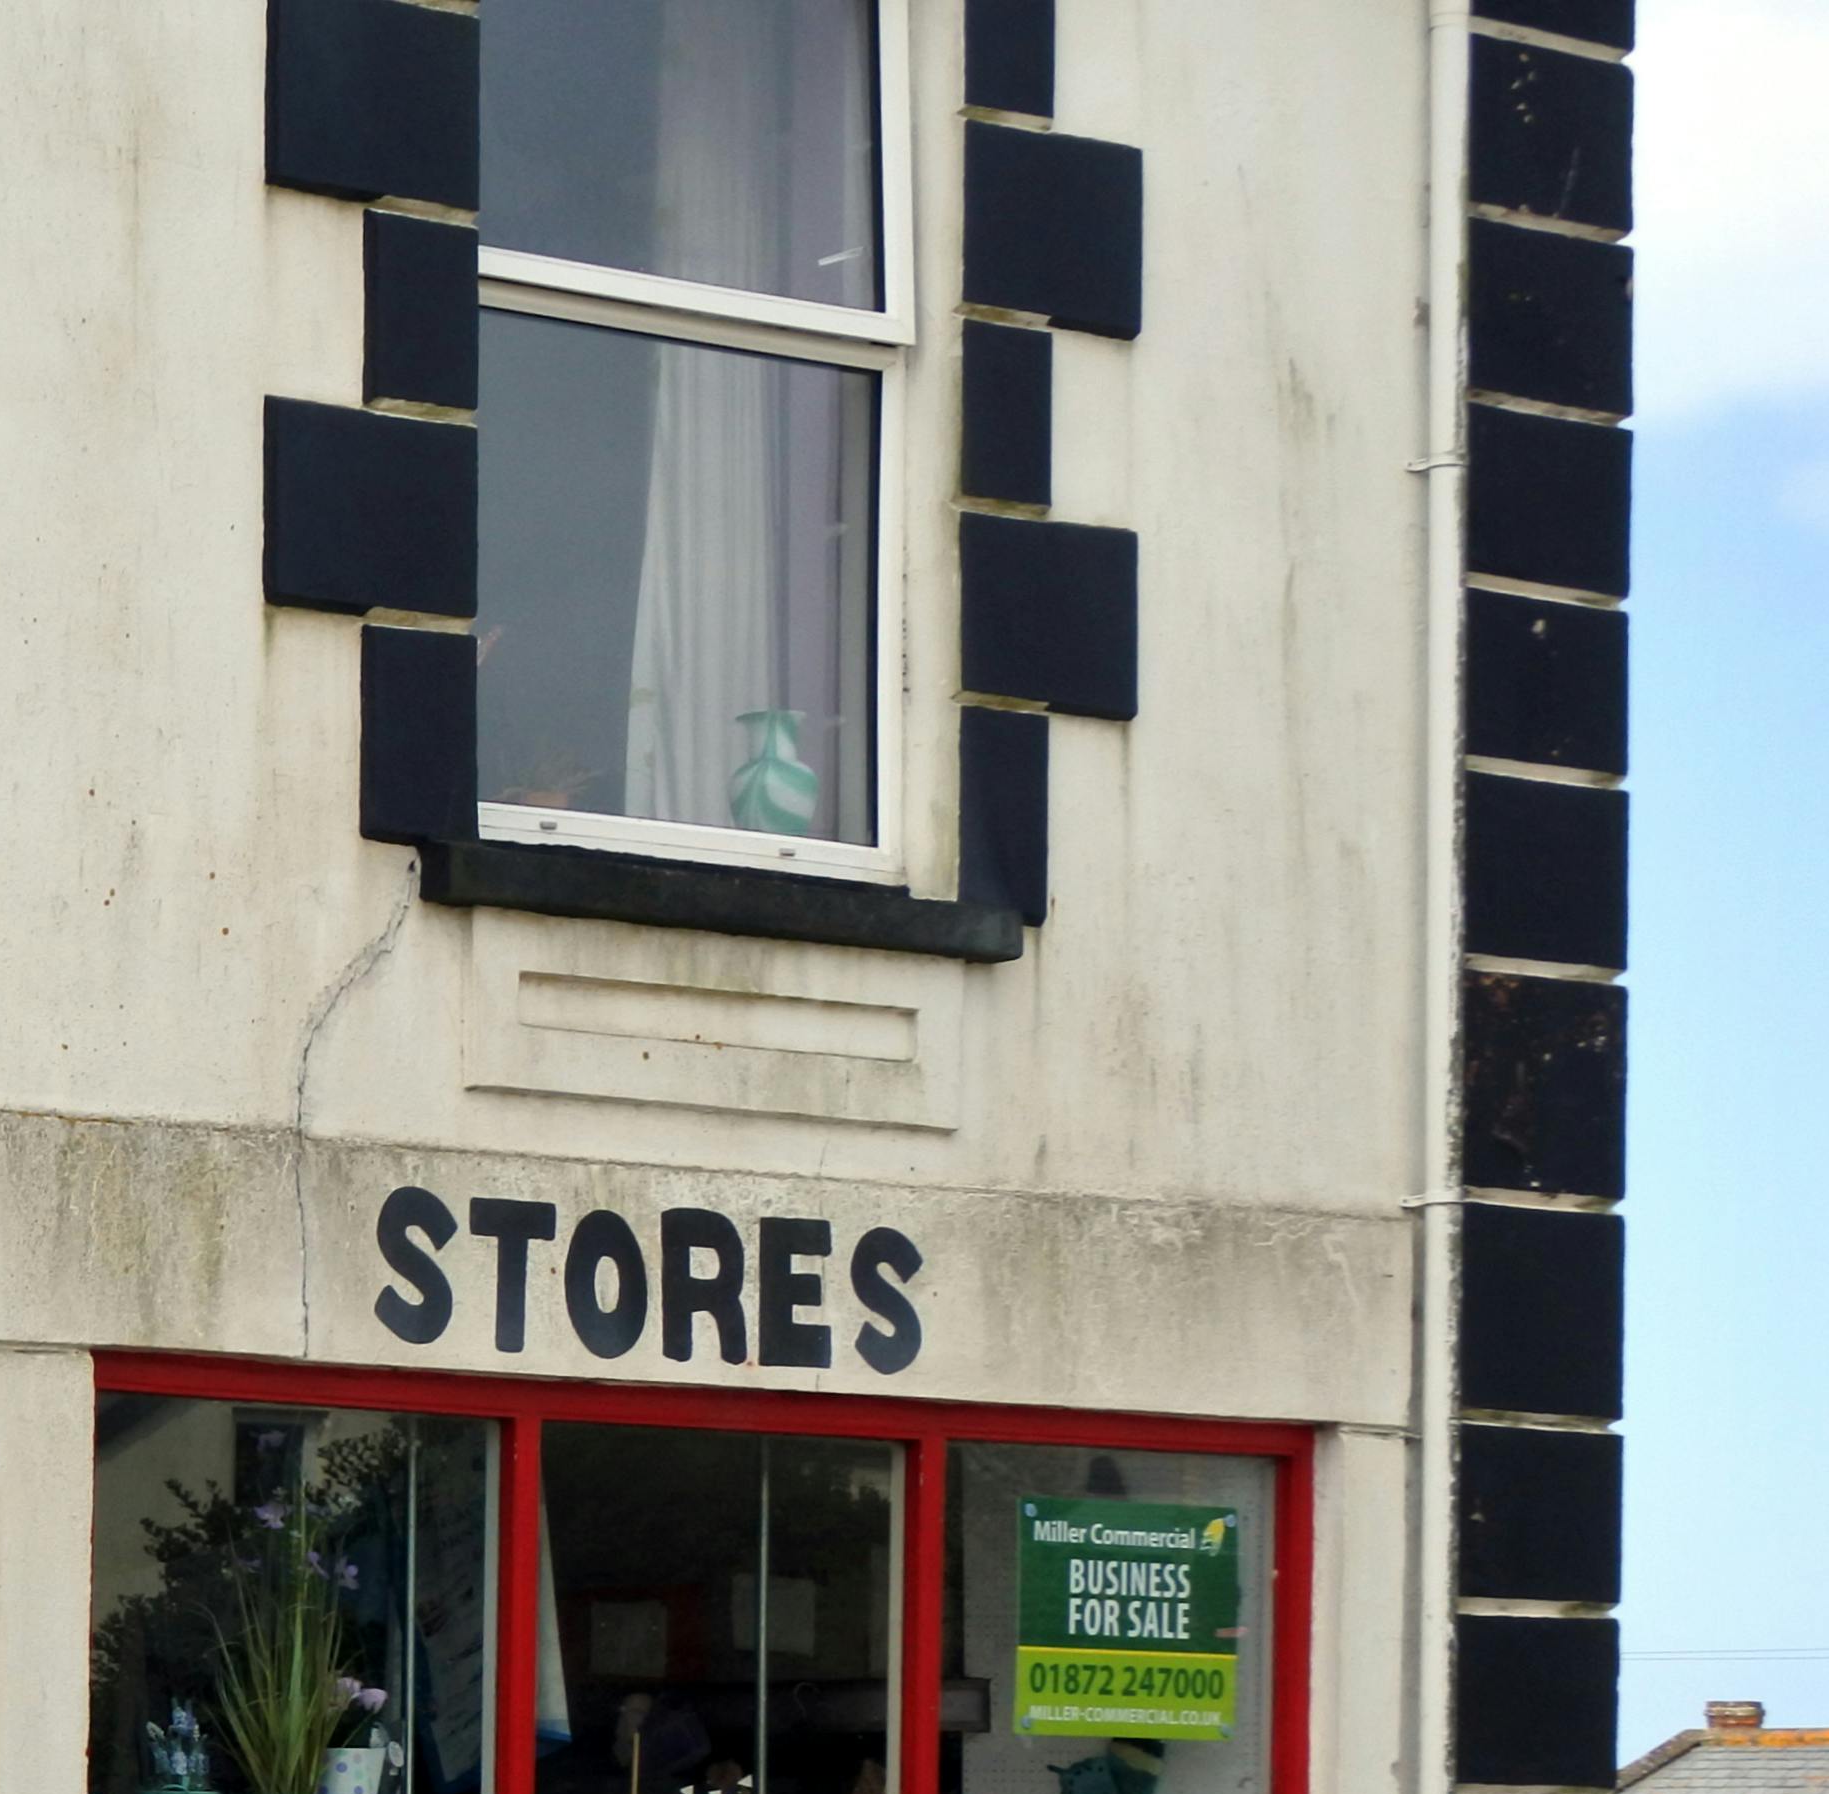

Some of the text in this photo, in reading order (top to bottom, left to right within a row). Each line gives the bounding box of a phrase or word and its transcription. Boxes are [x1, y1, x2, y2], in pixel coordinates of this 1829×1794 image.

[374, 1186, 923, 1375] STORES
[1033, 1520, 1196, 1549] Miller Commercial
[1069, 1559, 1192, 1599] BUSINESS
[1068, 1598, 1191, 1640] FOR SALE
[1029, 1662, 1225, 1699] 01872 247000
[1028, 1705, 1222, 1726] MILLER-COMMERCIAL.CO.UK
